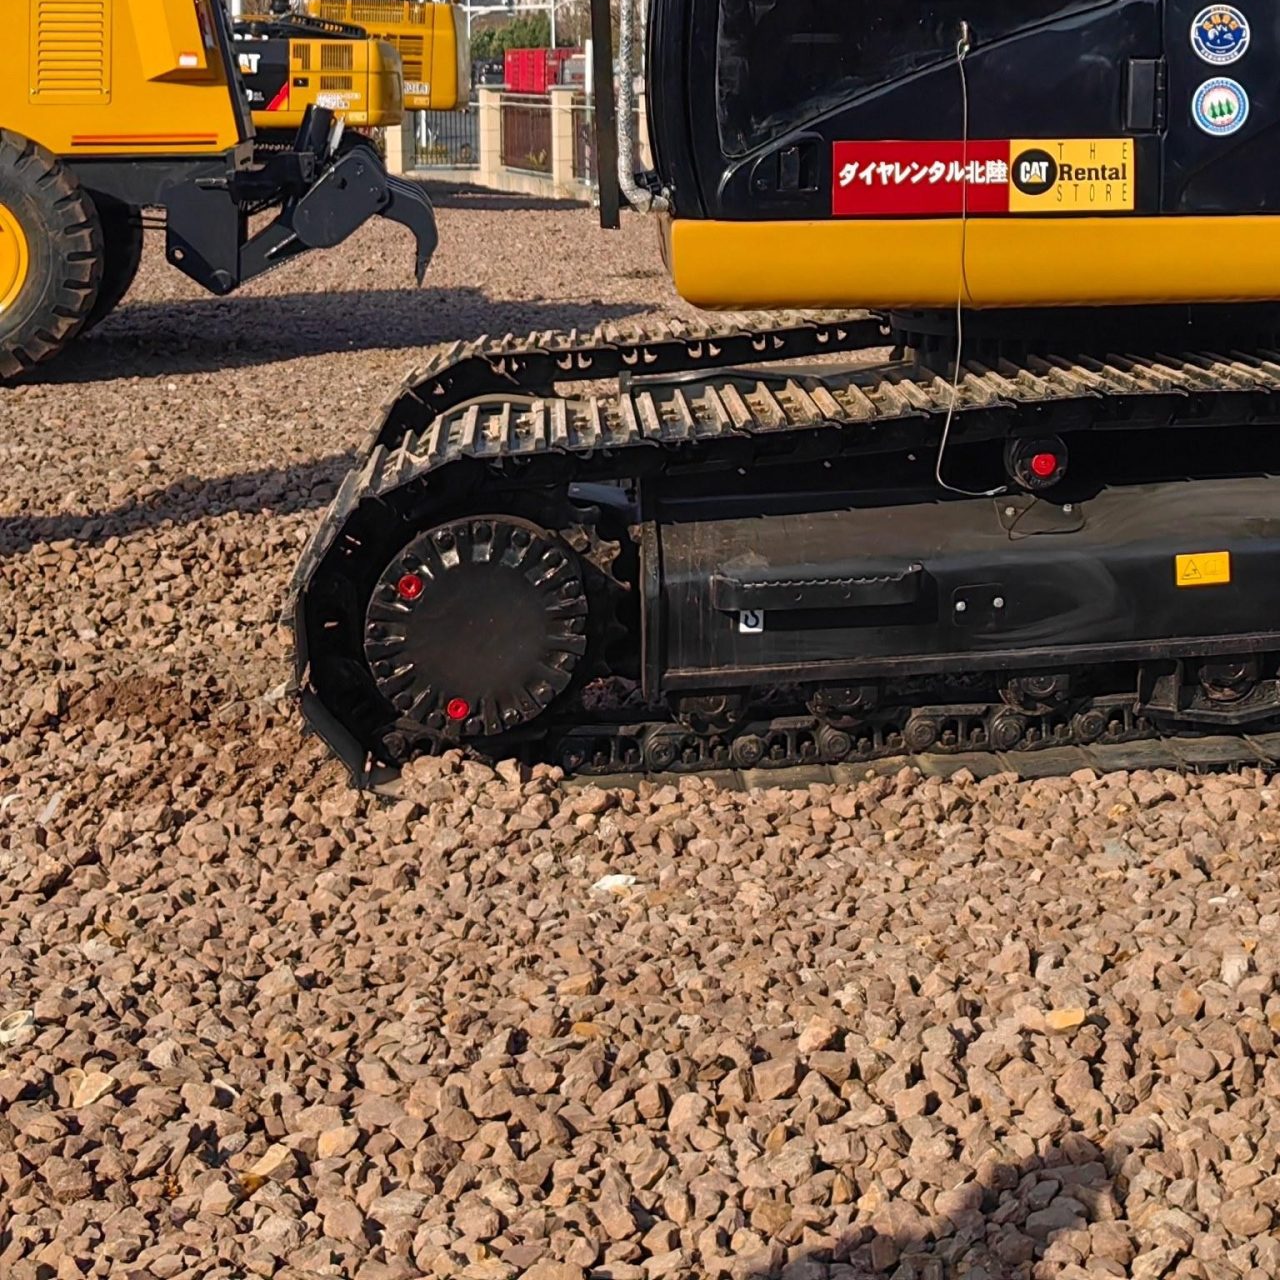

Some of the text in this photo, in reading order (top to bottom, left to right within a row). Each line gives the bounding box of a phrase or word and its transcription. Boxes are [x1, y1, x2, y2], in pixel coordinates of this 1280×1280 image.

[1058, 142, 1127, 160] THE
[839, 159, 1008, 187] ダイヤレンタル北陸
[1020, 161, 1048, 184] CAT
[1058, 163, 1127, 181] Rental
[1057, 183, 1127, 202] STORE
